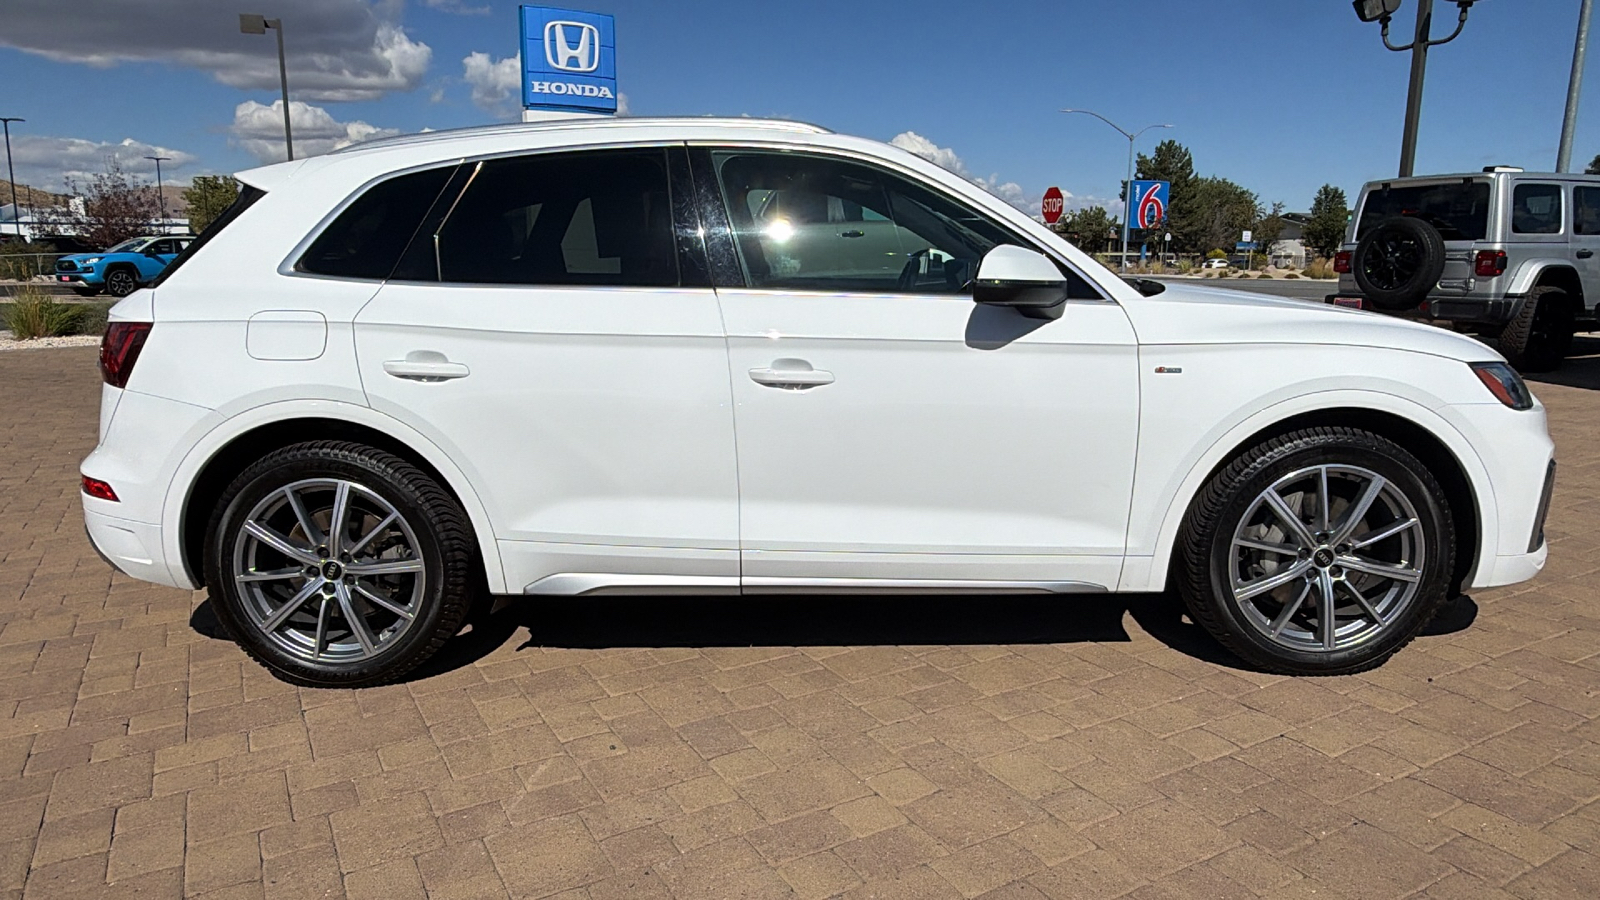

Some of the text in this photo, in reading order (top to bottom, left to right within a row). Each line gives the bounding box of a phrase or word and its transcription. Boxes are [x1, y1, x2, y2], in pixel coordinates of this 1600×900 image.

[531, 81, 614, 99] HONDA
[1043, 198, 1062, 212] STOP
[1138, 183, 1163, 229] 6
